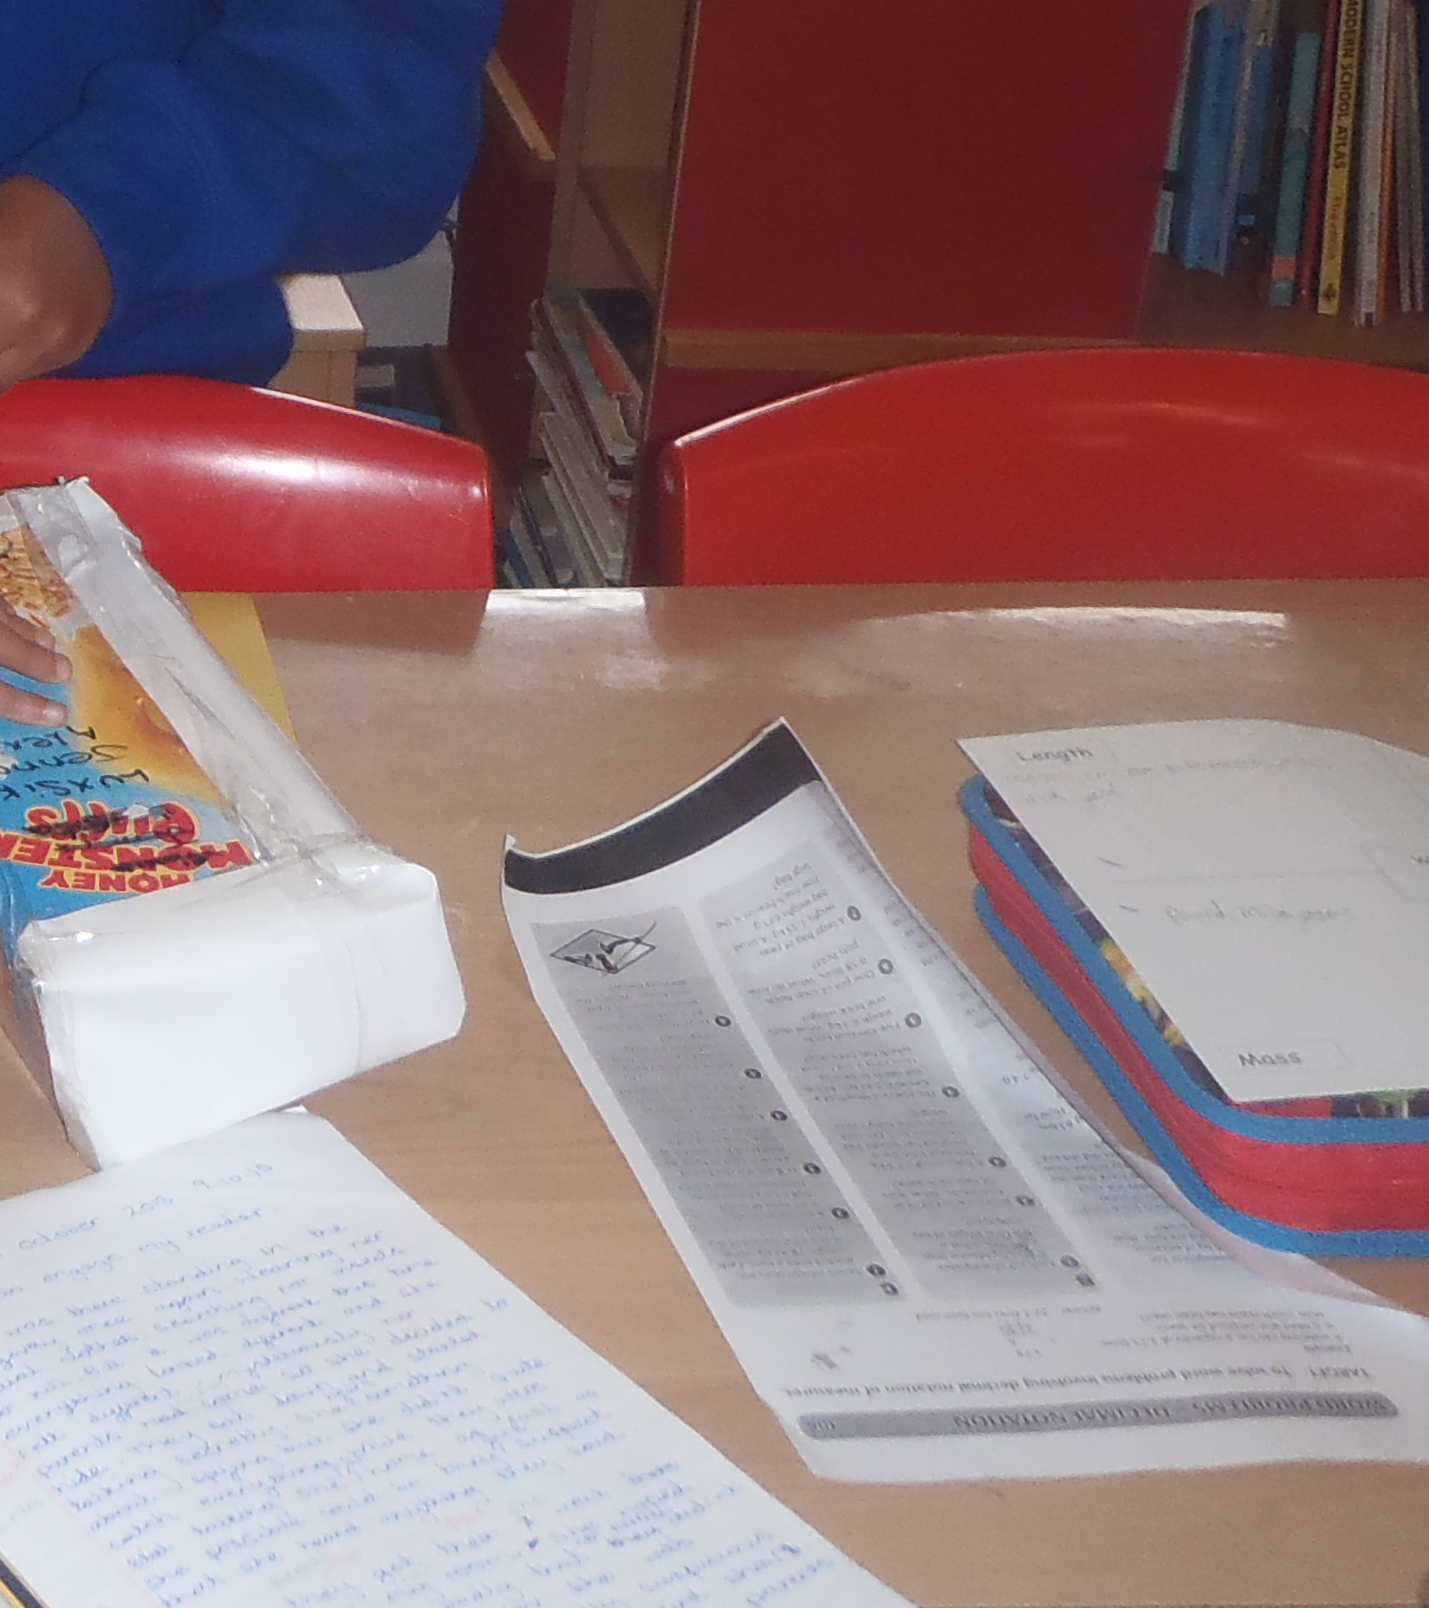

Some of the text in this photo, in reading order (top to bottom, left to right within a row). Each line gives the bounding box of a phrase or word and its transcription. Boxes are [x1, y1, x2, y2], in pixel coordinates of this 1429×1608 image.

[1335, 61, 1355, 119] SCHOOL
[1333, 124, 1349, 170] ATLAS
[1014, 743, 1094, 765] Length
[39, 869, 192, 893] HONEY
[1236, 1050, 1303, 1069] Mass
[1100, 1368, 1177, 1385] problems
[1307, 1365, 1369, 1379] TARGET
[886, 1381, 953, 1395] notation
[957, 1378, 1019, 1393] decimal
[1022, 1375, 1099, 1390] involving
[952, 1409, 1067, 1430] NOTATION
[1073, 1403, 1171, 1424] DECIMAL
